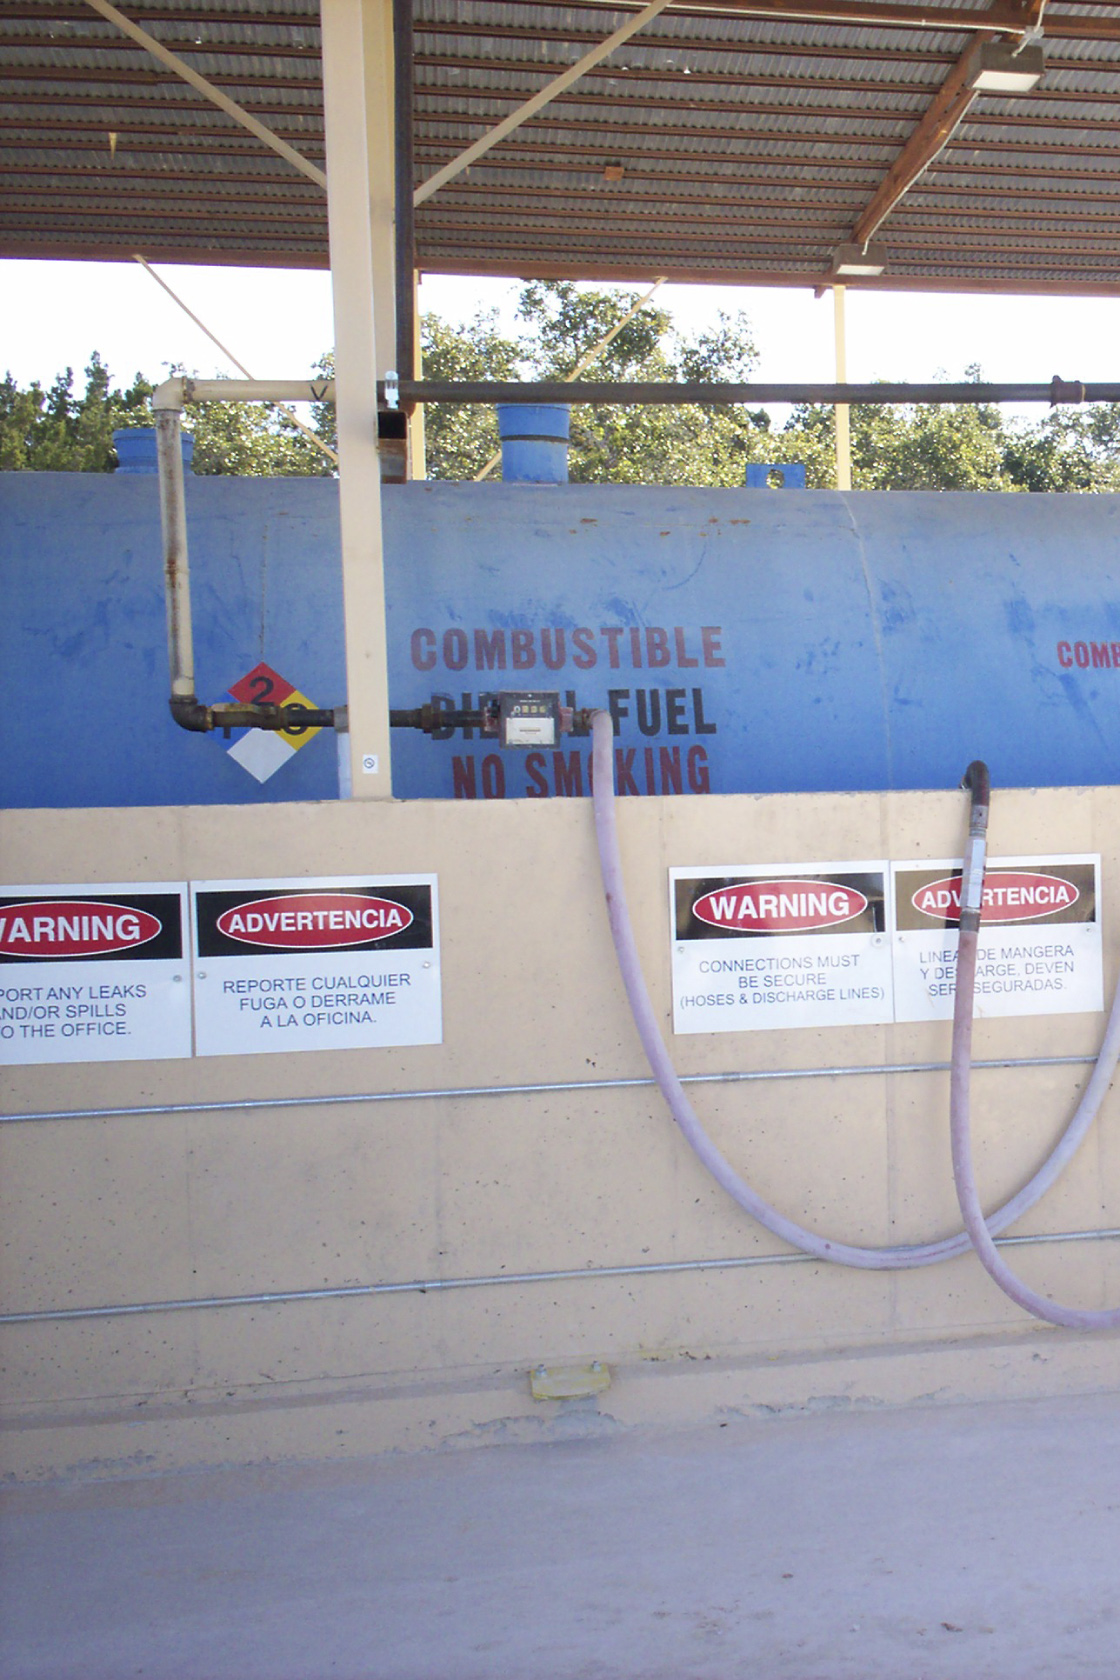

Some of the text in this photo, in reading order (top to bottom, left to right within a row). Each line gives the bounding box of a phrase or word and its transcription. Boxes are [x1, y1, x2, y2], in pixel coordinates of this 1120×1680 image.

[411, 626, 725, 671] COMBUSTIBLE
[249, 676, 275, 706] 2
[608, 688, 716, 735] FUEL
[453, 745, 711, 799] NO SMKING
[709, 891, 849, 920] WARNING
[922, 885, 1070, 909] ADVRTENCIA
[0, 914, 140, 943] ARNING
[228, 908, 403, 933] ADVERTENCIA
[977, 949, 996, 961] DE
[1001, 945, 1075, 959] MANGERA
[699, 954, 860, 973] CONNECTIONS MUST
[920, 961, 1075, 980] Y DEARGE, DEVEN
[223, 973, 411, 993] REPORTE CUALQUIER
[739, 973, 827, 988] BE SECURE
[974, 977, 1067, 994] SEGURADAS.
[46, 986, 83, 1000] ANY
[89, 984, 147, 999] LEAKS
[240, 992, 396, 1011] FUGA O DERRAME
[680, 987, 885, 1009] (HOSES & DISCHARGE LINES)
[0, 1003, 127, 1020] ND/OR SPILLS
[260, 1011, 377, 1028] A LA OFICINA.
[19, 1024, 55, 1038] THE
[61, 1022, 131, 1037] OFFICE.
